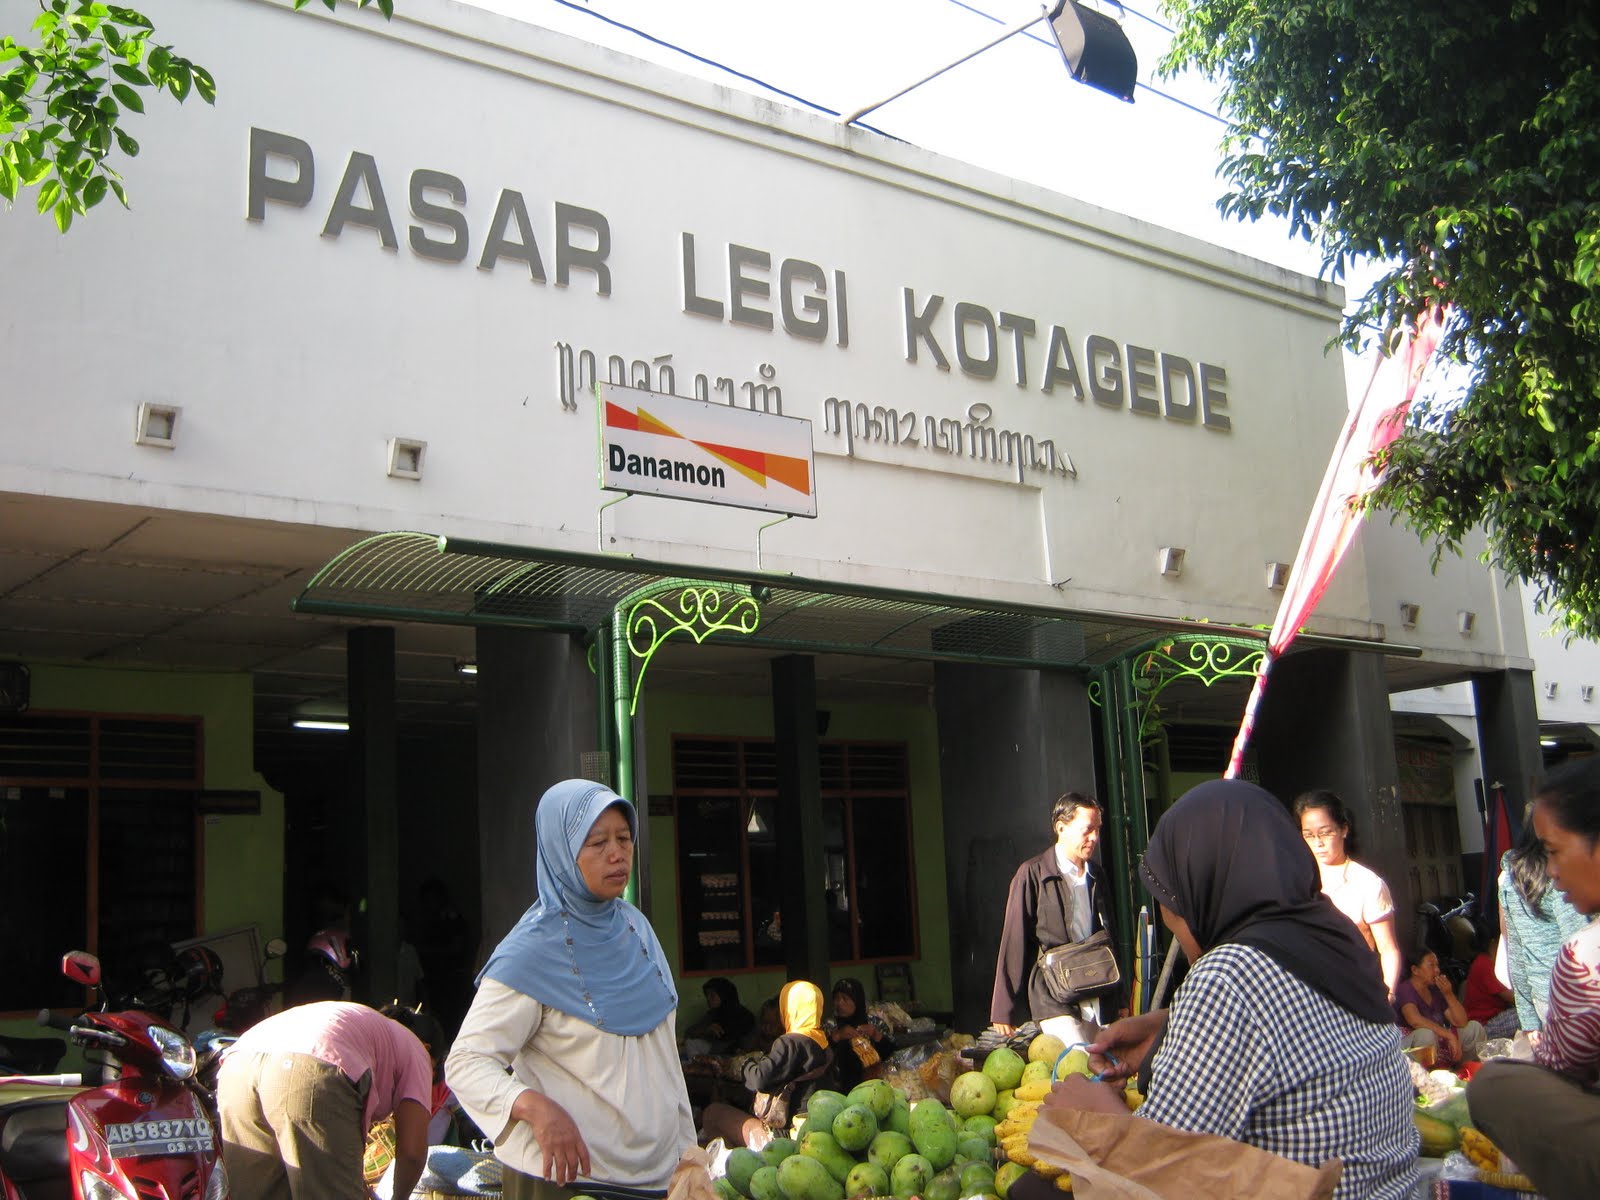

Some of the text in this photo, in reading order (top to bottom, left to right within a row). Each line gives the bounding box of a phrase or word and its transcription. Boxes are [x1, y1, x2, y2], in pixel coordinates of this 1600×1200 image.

[245, 127, 1232, 430] PASAR LEGI KOTAGEDE
[608, 443, 726, 489] Danamon
